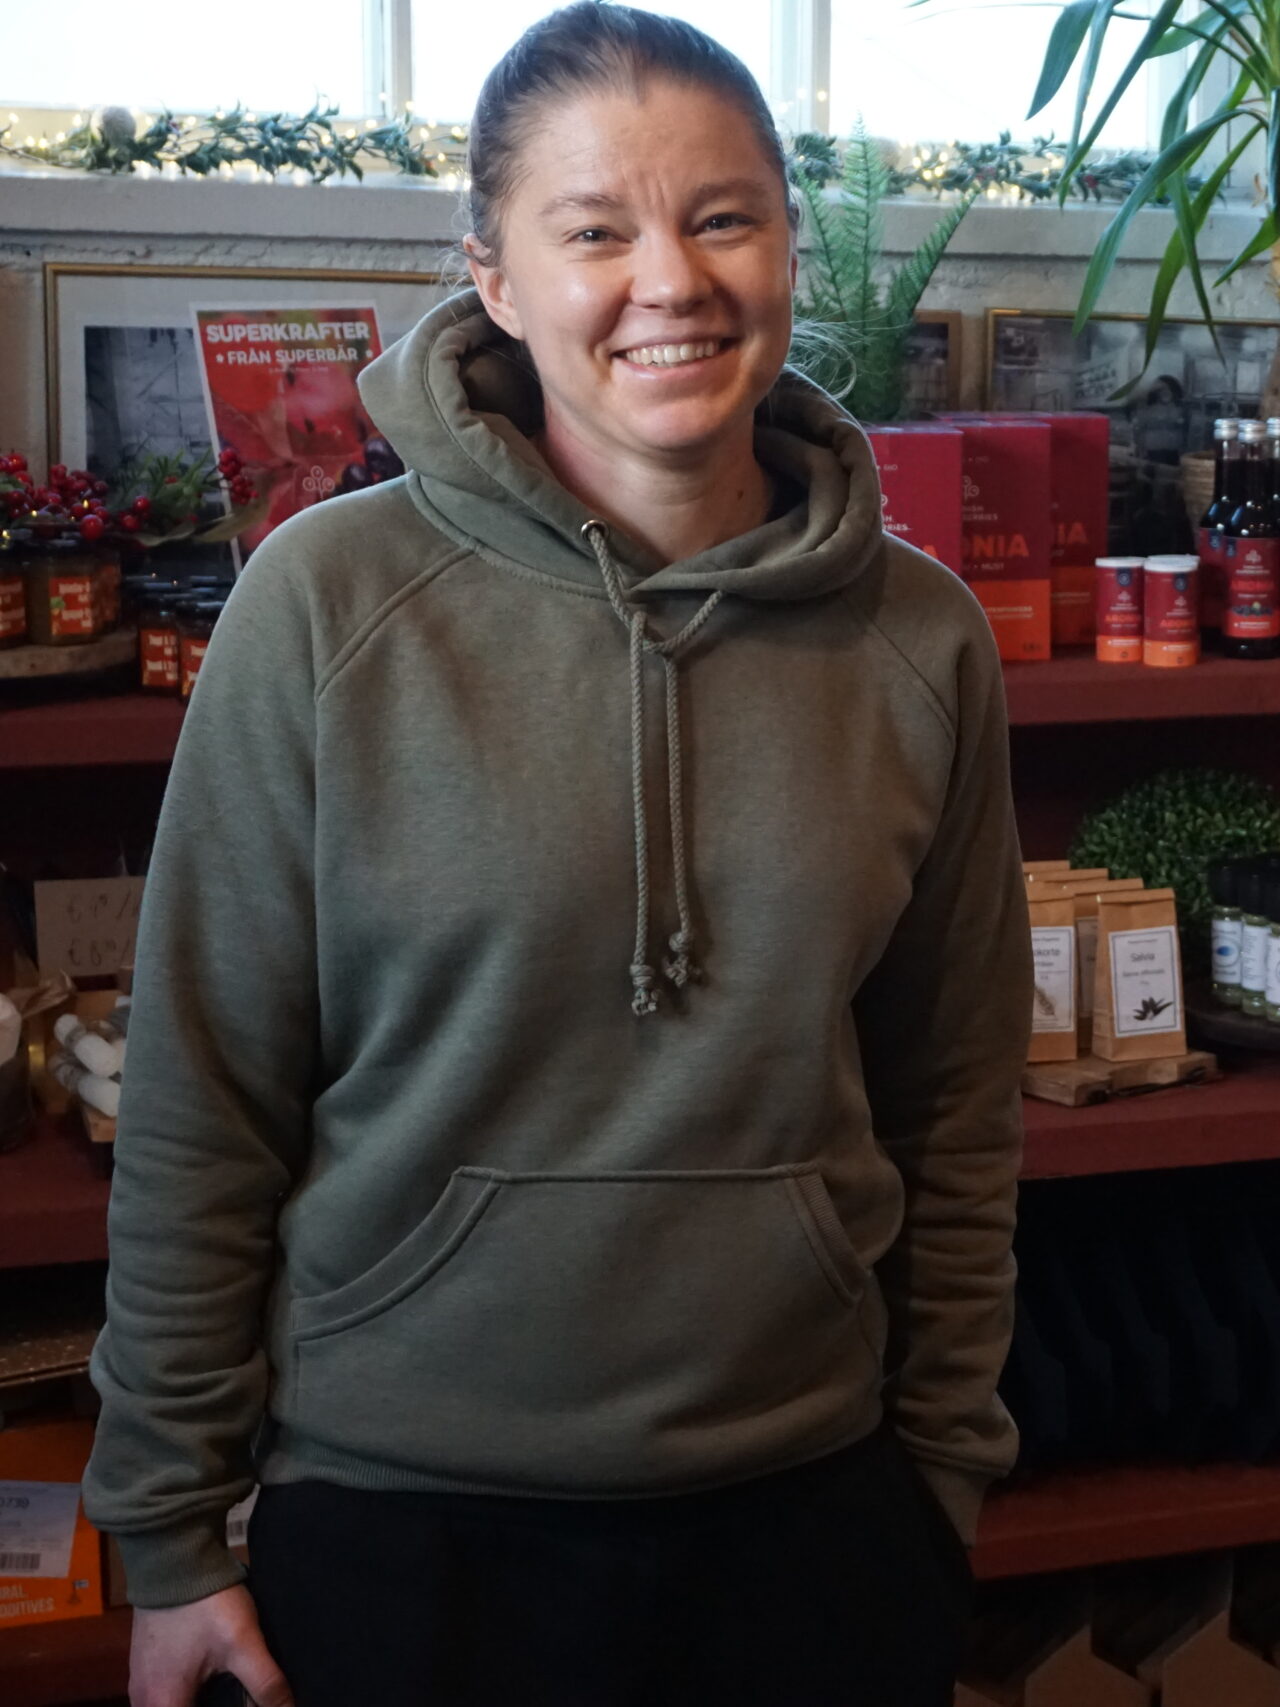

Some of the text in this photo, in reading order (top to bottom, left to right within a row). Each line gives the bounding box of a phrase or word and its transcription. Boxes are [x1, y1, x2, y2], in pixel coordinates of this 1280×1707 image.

[206, 321, 370, 343] SUPERKRAFTER
[227, 344, 359, 365] FRÅN SUPERBÄR
